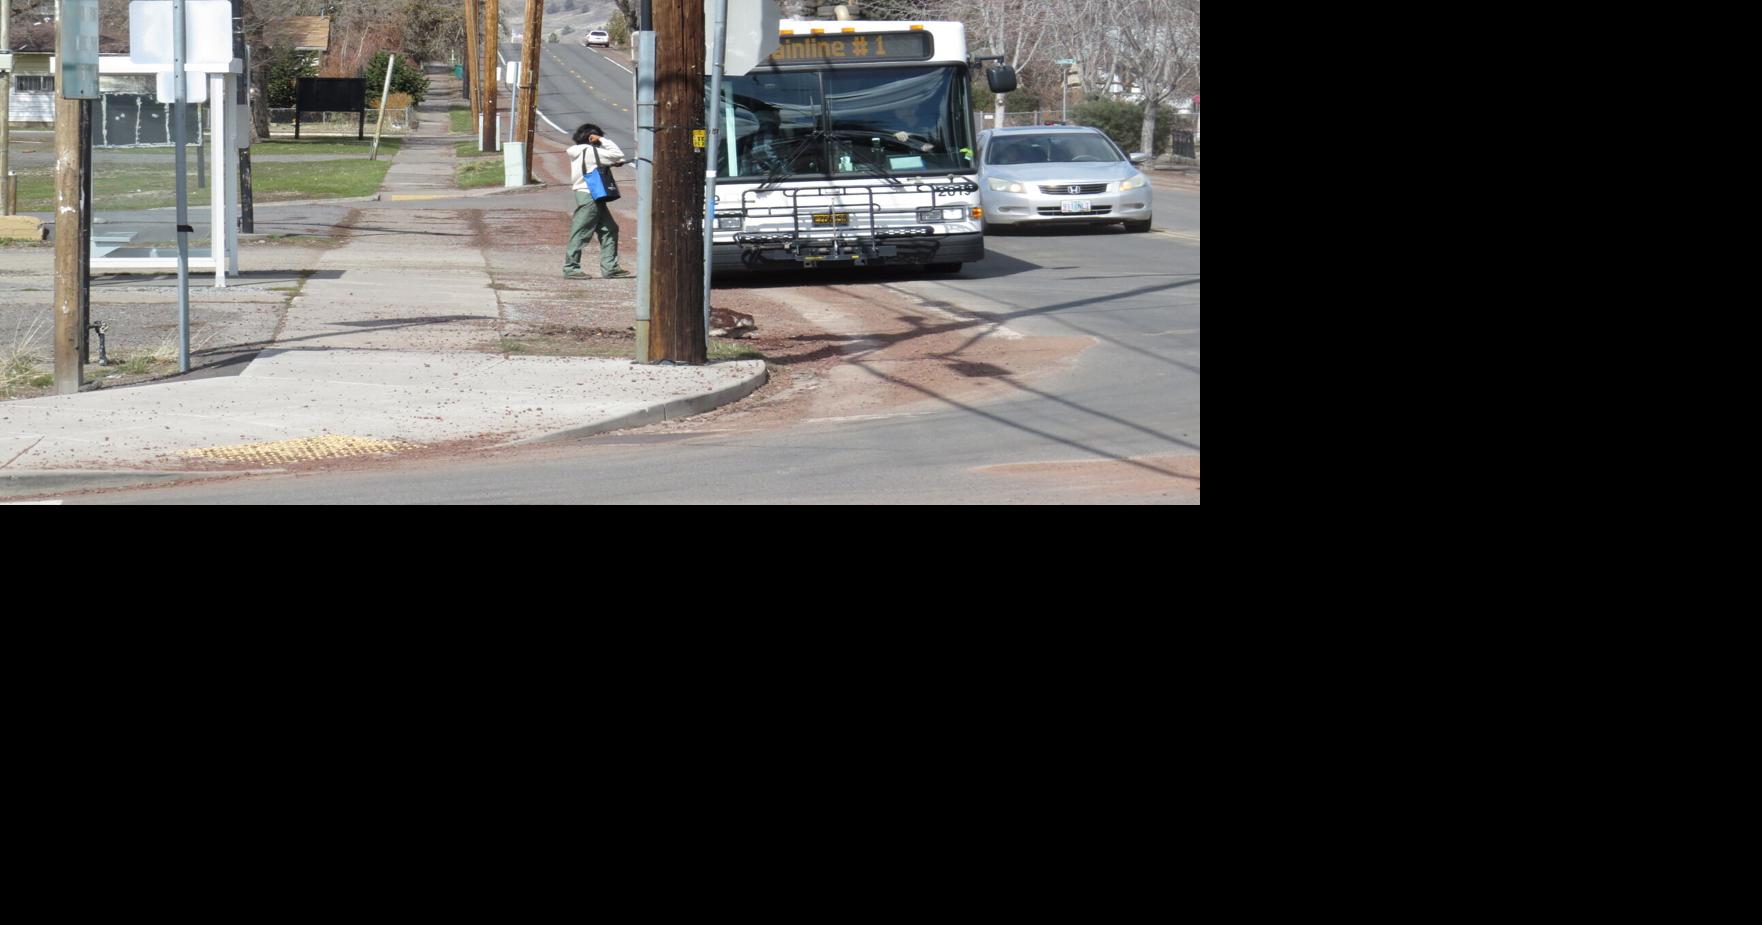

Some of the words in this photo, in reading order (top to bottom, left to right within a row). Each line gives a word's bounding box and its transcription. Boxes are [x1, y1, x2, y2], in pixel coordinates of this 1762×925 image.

[771, 38, 846, 60] ainline
[852, 35, 868, 57] #
[875, 35, 886, 57] 1
